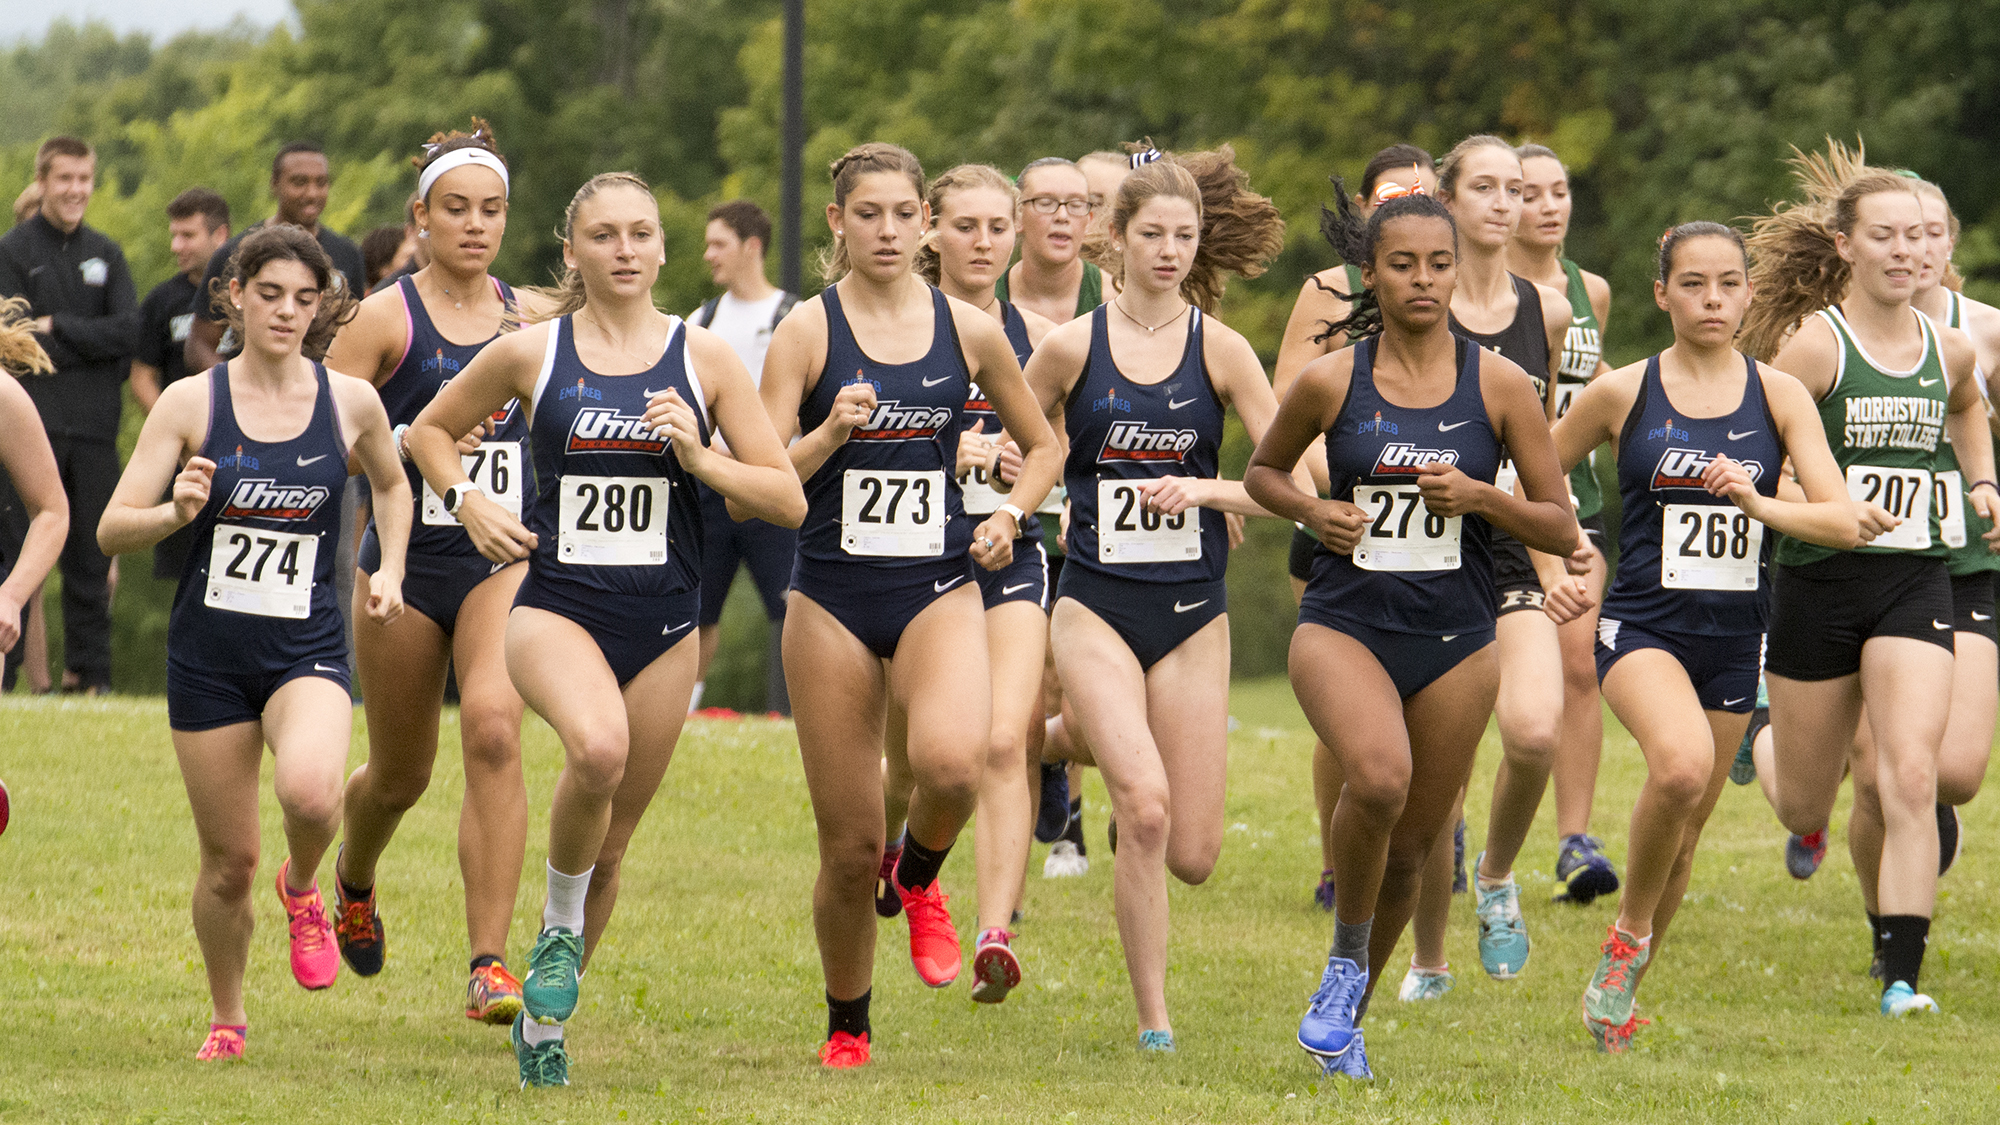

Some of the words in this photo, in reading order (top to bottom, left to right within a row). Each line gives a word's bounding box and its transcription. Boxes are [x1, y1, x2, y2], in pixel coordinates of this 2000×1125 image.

[862, 404, 949, 430] UTICA
[1845, 396, 1945, 426] MORRISVILLE
[1108, 425, 1194, 451] UTICA
[1381, 445, 1456, 466] UTICA
[1844, 423, 1891, 448] STATE
[1888, 423, 1941, 452] COLLEGE
[467, 449, 509, 494] 76
[232, 483, 325, 509] UTICA
[576, 483, 653, 532] 280
[858, 477, 930, 525] 273
[1370, 490, 1446, 539] 278
[1861, 473, 1921, 518] 207
[1678, 511, 1750, 560] 268
[225, 533, 300, 585] 274
